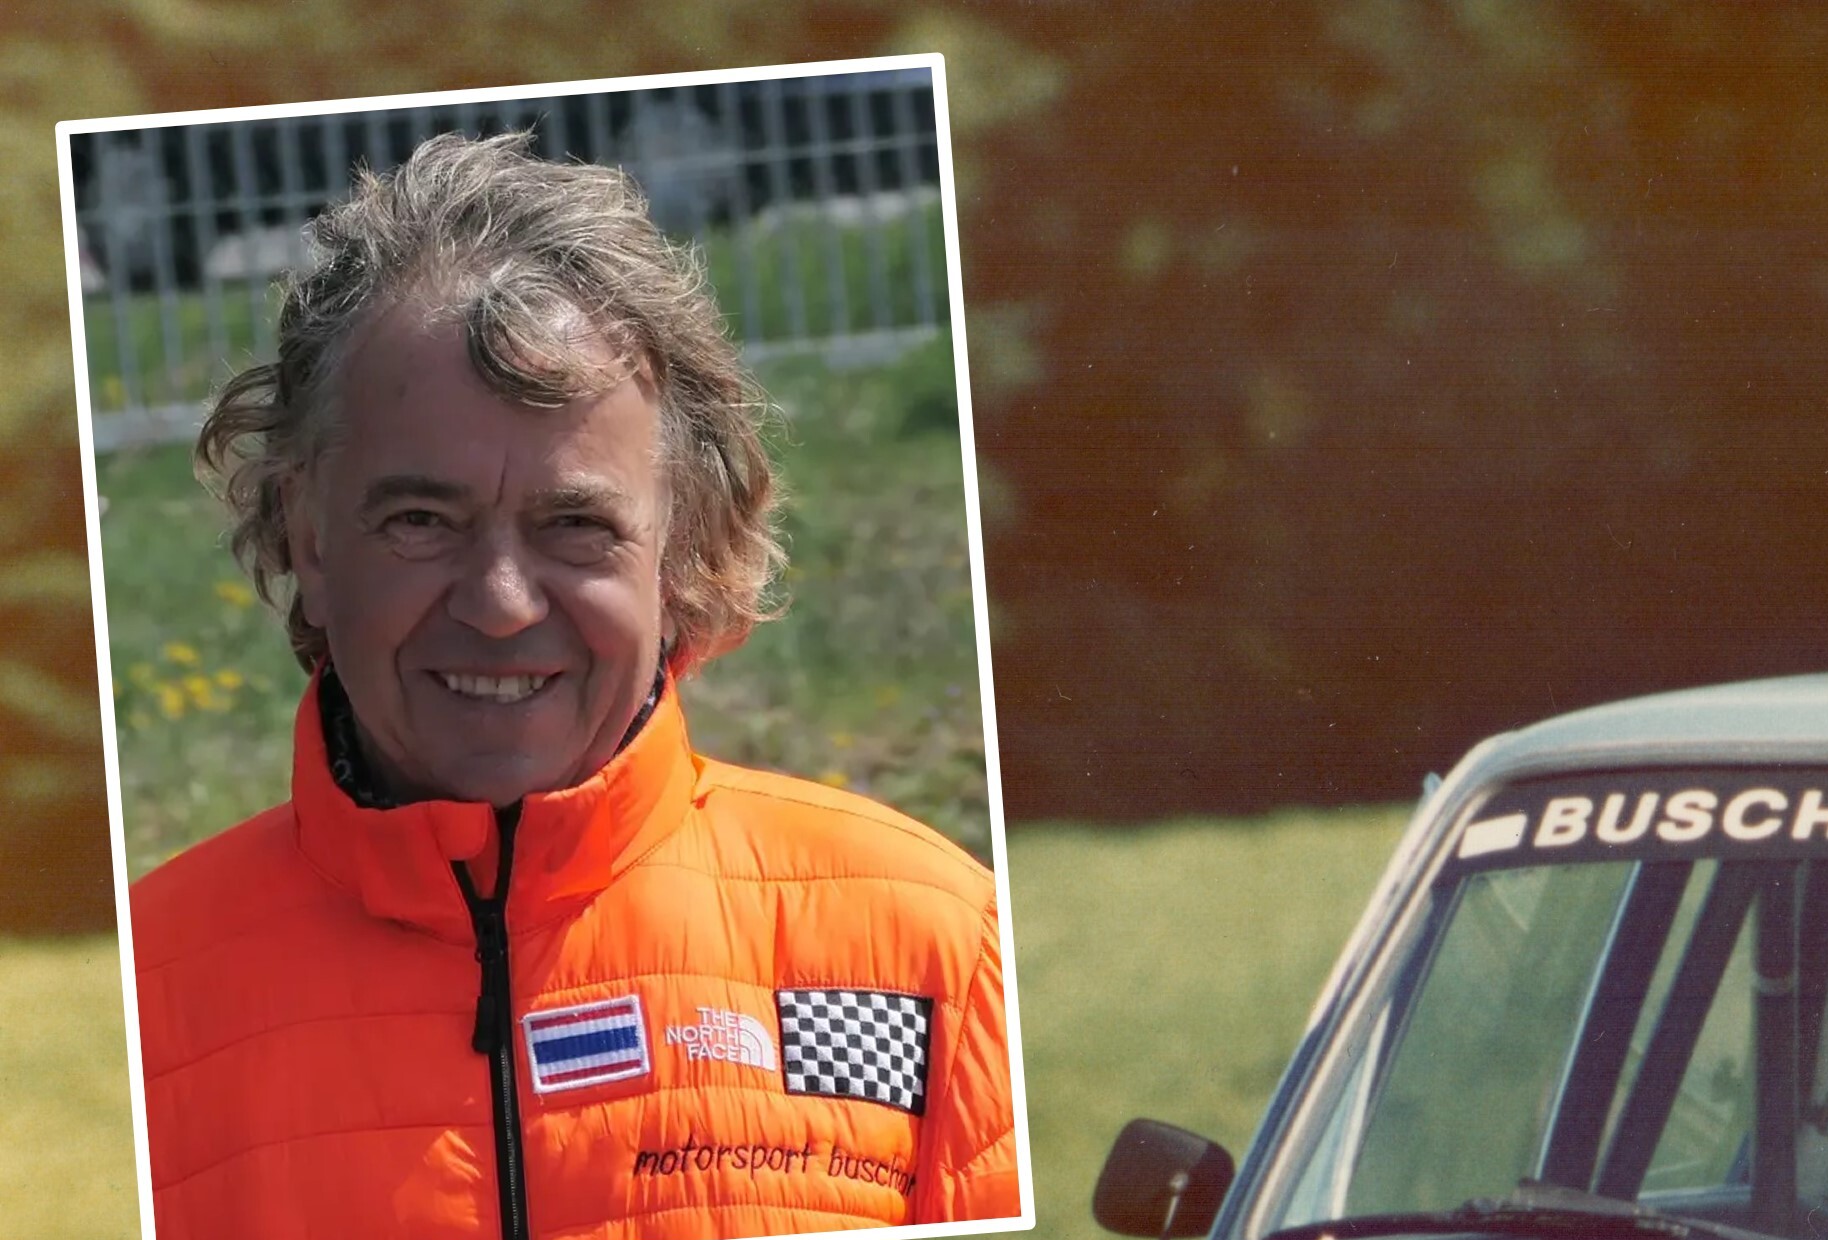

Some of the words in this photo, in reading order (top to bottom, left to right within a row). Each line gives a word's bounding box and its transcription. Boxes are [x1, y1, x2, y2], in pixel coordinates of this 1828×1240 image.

[695, 1007, 738, 1027] THE
[665, 1024, 739, 1045] NORTH
[687, 1043, 741, 1062] FACE
[633, 1133, 819, 1180] motorsport
[827, 1145, 917, 1197] buschor
